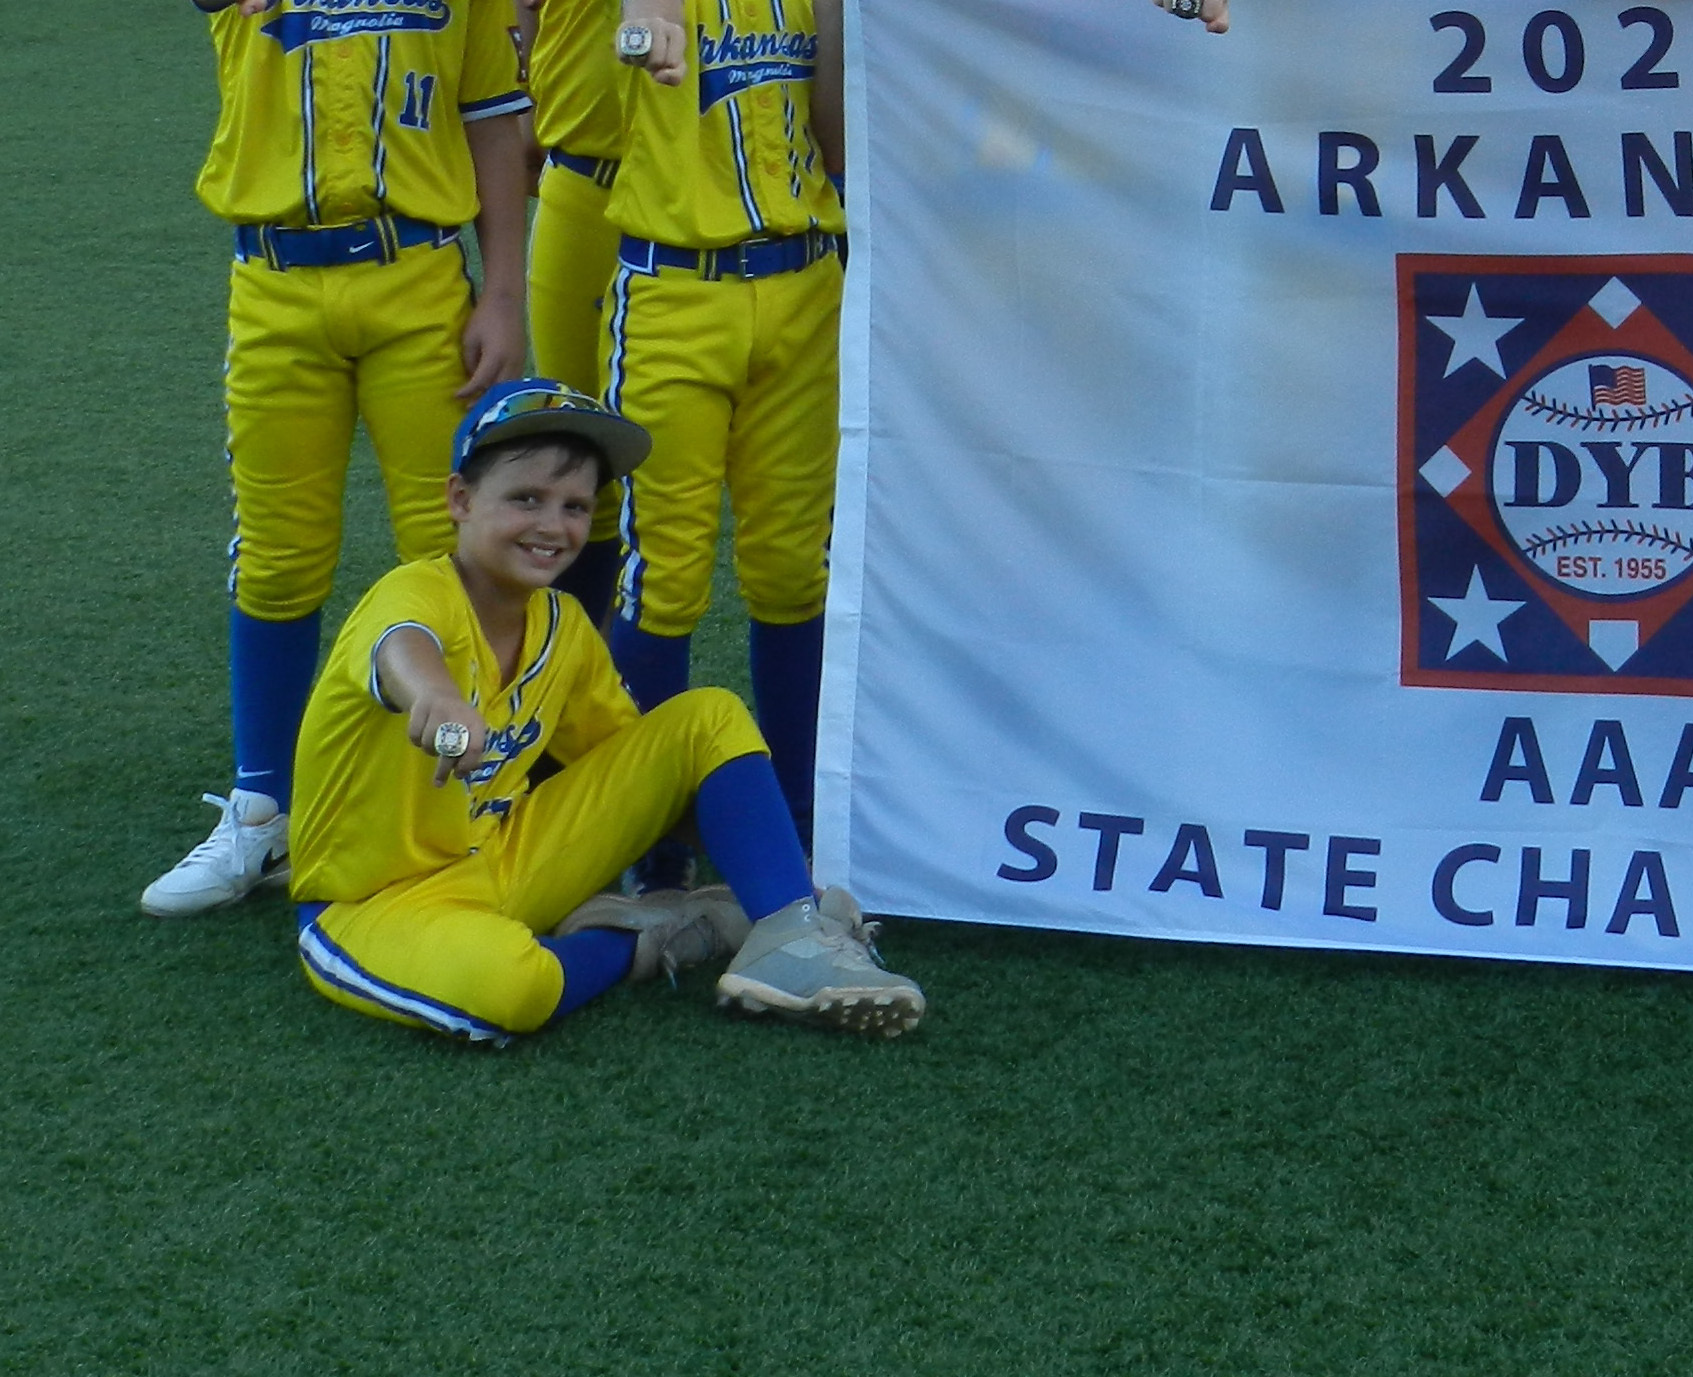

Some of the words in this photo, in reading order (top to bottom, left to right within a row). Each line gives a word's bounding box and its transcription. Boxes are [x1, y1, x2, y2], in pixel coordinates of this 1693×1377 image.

[400, 71, 436, 132] 11
[1557, 557, 1606, 578] EST.
[1614, 558, 1667, 580] 1955
[997, 804, 1381, 922] STATE
